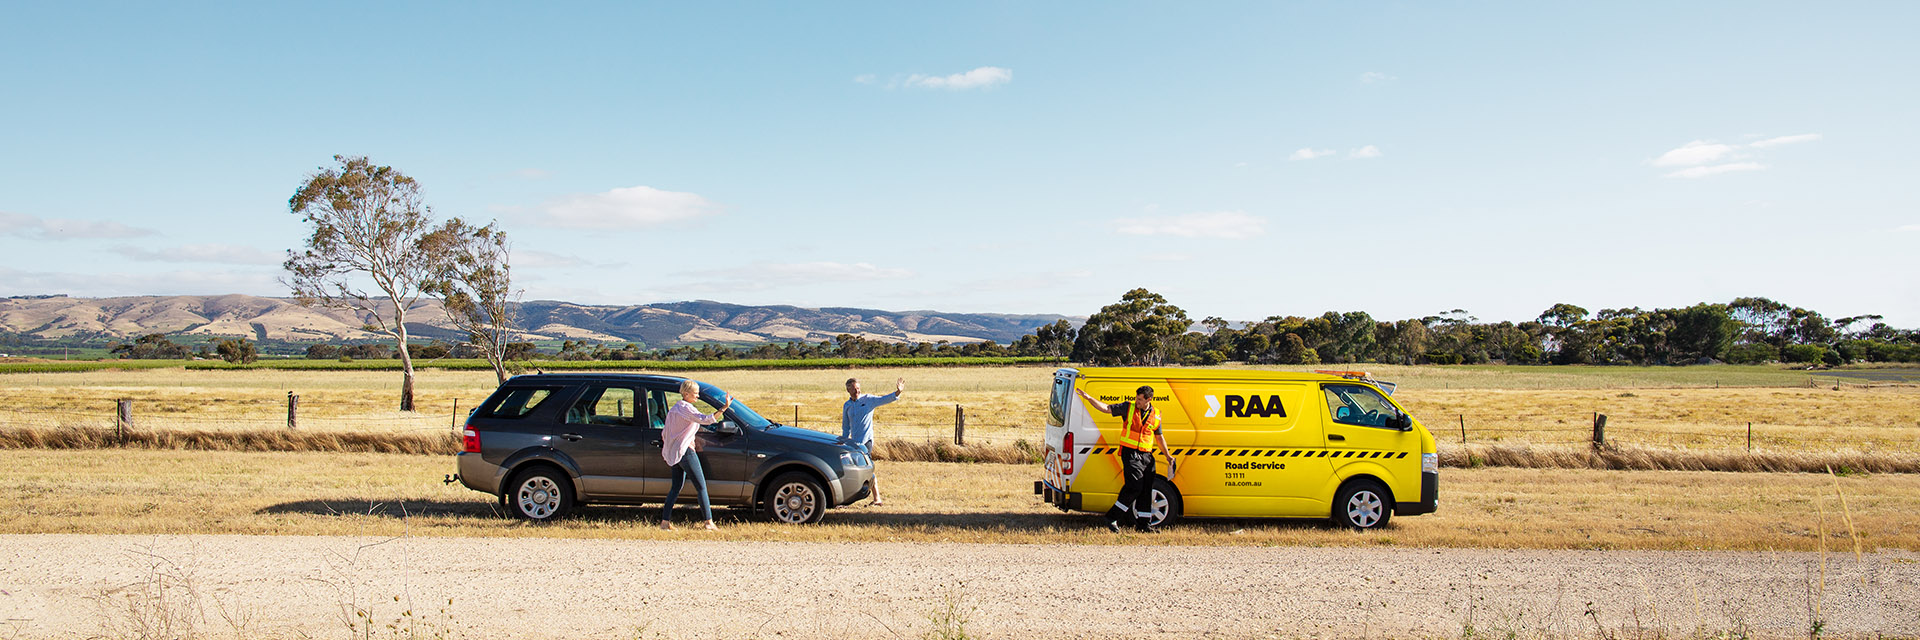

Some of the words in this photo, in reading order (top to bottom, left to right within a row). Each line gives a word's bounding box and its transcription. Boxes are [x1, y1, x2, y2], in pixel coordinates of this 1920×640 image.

[1225, 394, 1287, 418] RAA
[1225, 461, 1249, 470] Road
[1250, 461, 1286, 470] Service
